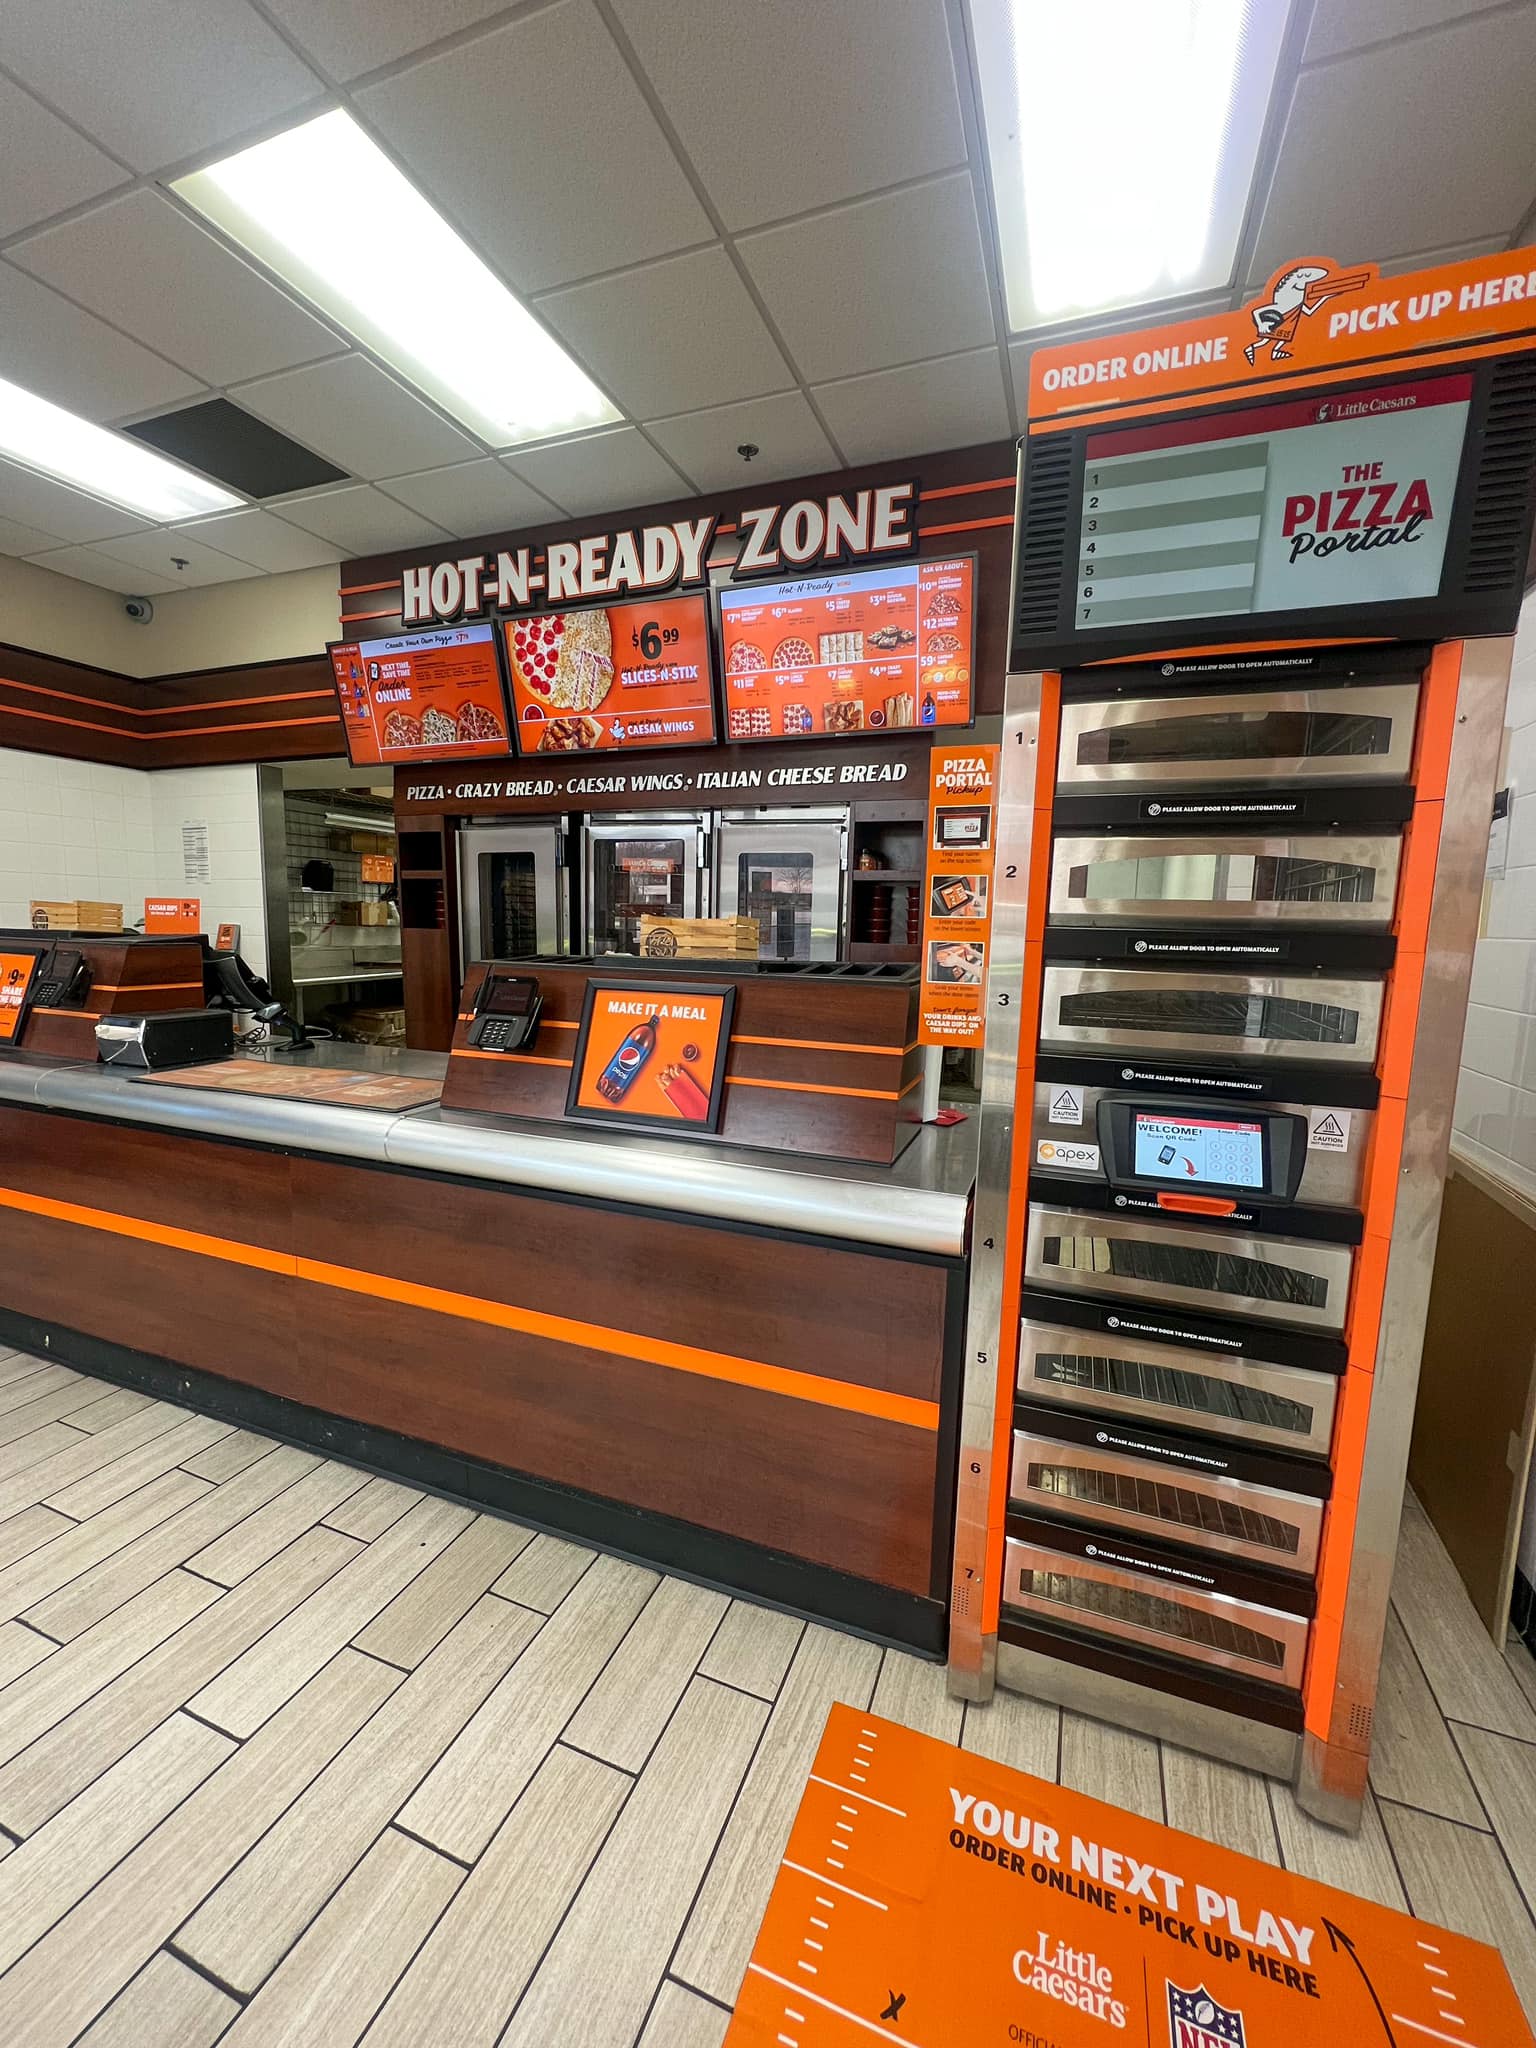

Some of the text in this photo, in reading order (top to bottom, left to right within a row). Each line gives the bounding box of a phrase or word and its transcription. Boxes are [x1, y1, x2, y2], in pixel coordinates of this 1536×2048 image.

[1329, 300, 1400, 338] PICK
[1408, 290, 1453, 321] UP
[1043, 337, 1229, 391] ORDER ONLINE
[1337, 396, 1416, 417] Little Caesars
[1093, 474, 1099, 485] 1
[1342, 462, 1383, 483] THE
[1089, 497, 1099, 508] 2
[1282, 479, 1433, 537] PIZZA
[1088, 520, 1097, 531] 3
[1289, 509, 1427, 564] Portal
[403, 483, 913, 622] HOT-N-READY ZONE
[1087, 542, 1096, 553] 4
[1085, 565, 1094, 576] 5
[1084, 587, 1093, 598] 6
[1083, 608, 1091, 619] 7
[1263, 658, 1313, 667] AUTOMATICALLY
[621, 665, 698, 685] SLICES-N-STIX
[375, 688, 412, 703] ONLINE
[627, 721, 694, 735] CAESAR WINGS
[1015, 731, 1023, 744] 1
[944, 758, 986, 773] PIZZA
[407, 764, 907, 800] PIZZA CRAZY BREAD CAESAR WINGS ITALIAN CHEESE BREAD
[936, 772, 992, 788] PORTAL
[1005, 865, 1017, 878] 2
[998, 993, 1010, 1006] 3
[608, 1001, 707, 1020] MAKE IT A MEAL
[612, 1066, 628, 1079] pepsi
[1216, 1080, 1263, 1090] AUTOMATICALLY
[1138, 1123, 1202, 1136] WELCOME!
[1056, 1148, 1095, 1162] apex
[984, 1238, 994, 1250] 4
[1121, 1321, 1139, 1329] PLEASE
[1140, 1324, 1158, 1332] ALLOW
[1198, 1334, 1242, 1347] AUTOMATICALLY
[977, 1352, 987, 1364] 5
[1109, 1437, 1127, 1445] PLEASE
[1128, 1441, 1145, 1449] ALLOW
[1146, 1445, 1161, 1453] DOOR
[1170, 1450, 1184, 1458] OPEN
[1184, 1454, 1228, 1468] AUTOMATICALLY
[970, 1462, 981, 1474] 6
[964, 1568, 974, 1579] 7
[1098, 1549, 1116, 1559] PLEASE
[1116, 1554, 1134, 1563] ALLOW
[1135, 1559, 1149, 1568] DOOR
[1157, 1565, 1172, 1573] OPEN
[1172, 1569, 1215, 1584] AUTOMATICALLY
[950, 1787, 1315, 1966] YOUR NEXT PLAY
[950, 1829, 1320, 1999] ORDER ONLINE PICK UP HERE
[1036, 1930, 1112, 1992] Little
[1013, 1950, 1126, 2028] Caesars
